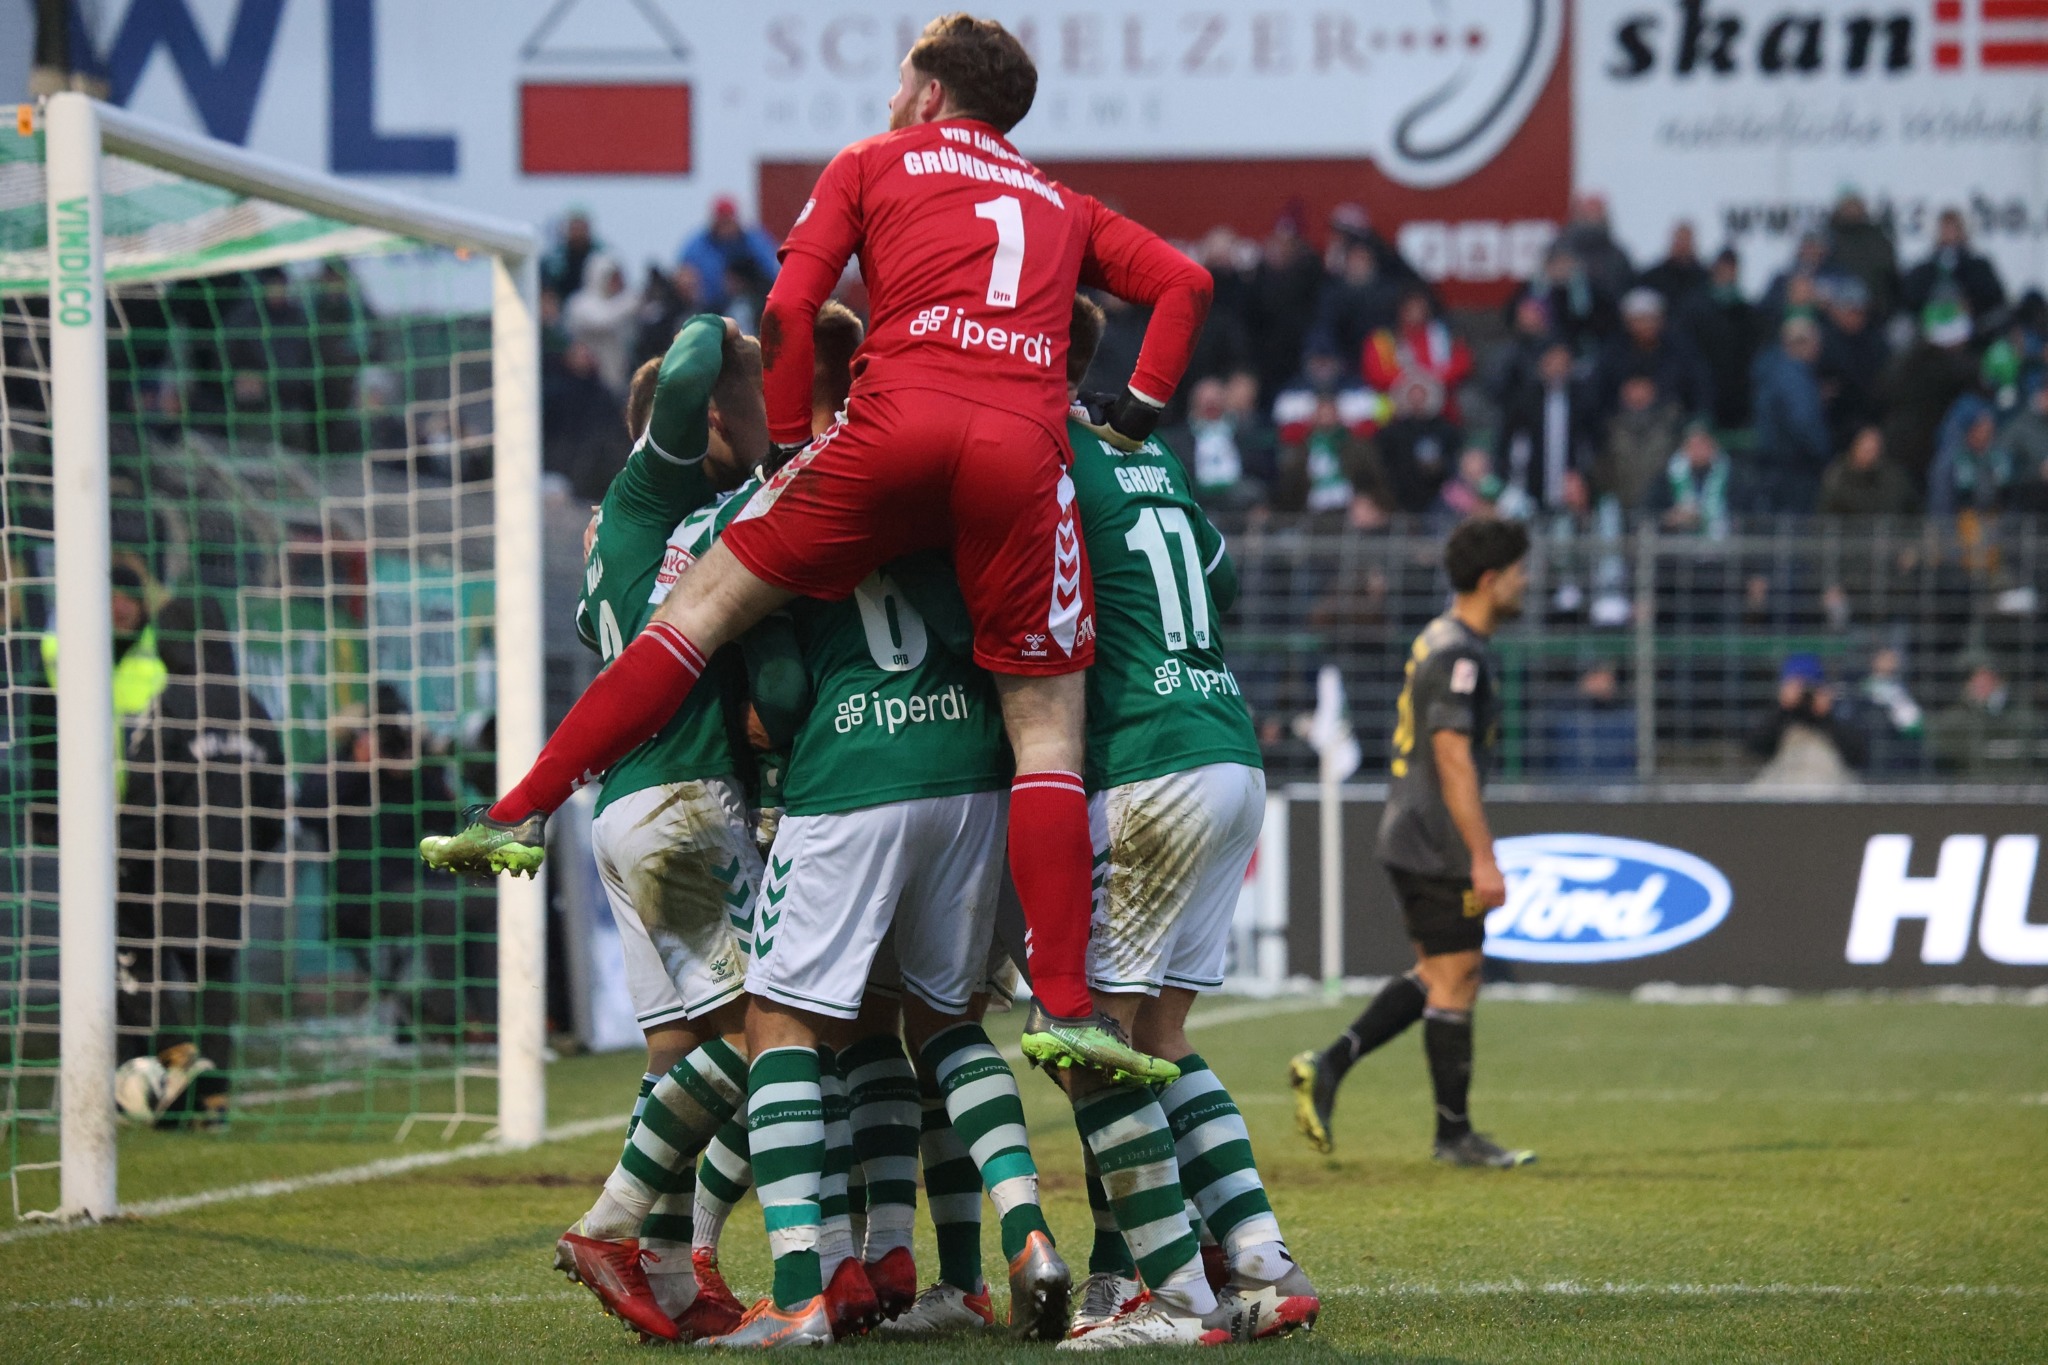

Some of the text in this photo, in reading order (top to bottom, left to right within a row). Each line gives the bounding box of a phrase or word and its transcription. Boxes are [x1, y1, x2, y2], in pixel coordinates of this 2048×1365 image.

[1604, 0, 1914, 79] skan
[904, 146, 1065, 211] GRÜNDEMANN
[56, 195, 92, 327] VINDICO
[975, 195, 1025, 308] 1
[952, 308, 1052, 368] iperdi
[1114, 465, 1174, 495] GRUPE
[1125, 507, 1210, 651] 17
[1021, 649, 1047, 657] hummel
[871, 684, 968, 735] iperdi
[1484, 857, 1668, 941] Ford
